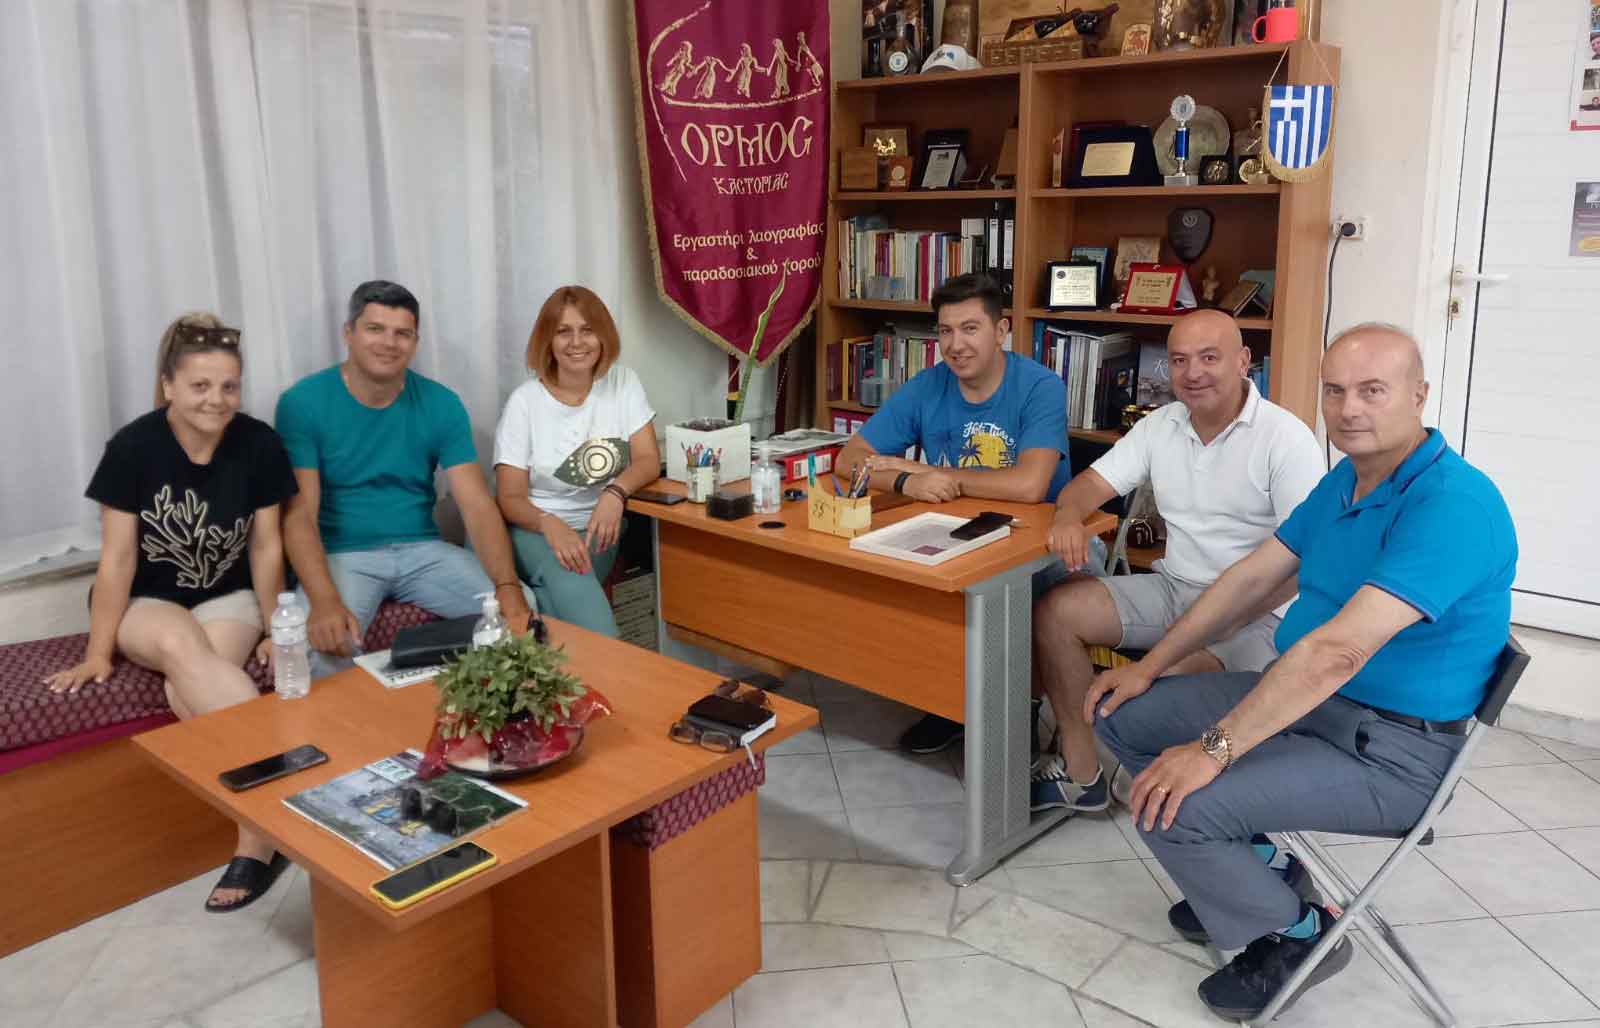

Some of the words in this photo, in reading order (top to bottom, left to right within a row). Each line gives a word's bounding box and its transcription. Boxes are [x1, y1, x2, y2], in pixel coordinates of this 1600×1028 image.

[673, 230, 744, 252] Εργαστήρι
[748, 220, 825, 245] λαογραφίας
[746, 246, 758, 260] &
[683, 259, 777, 284] παραδοσιακού
